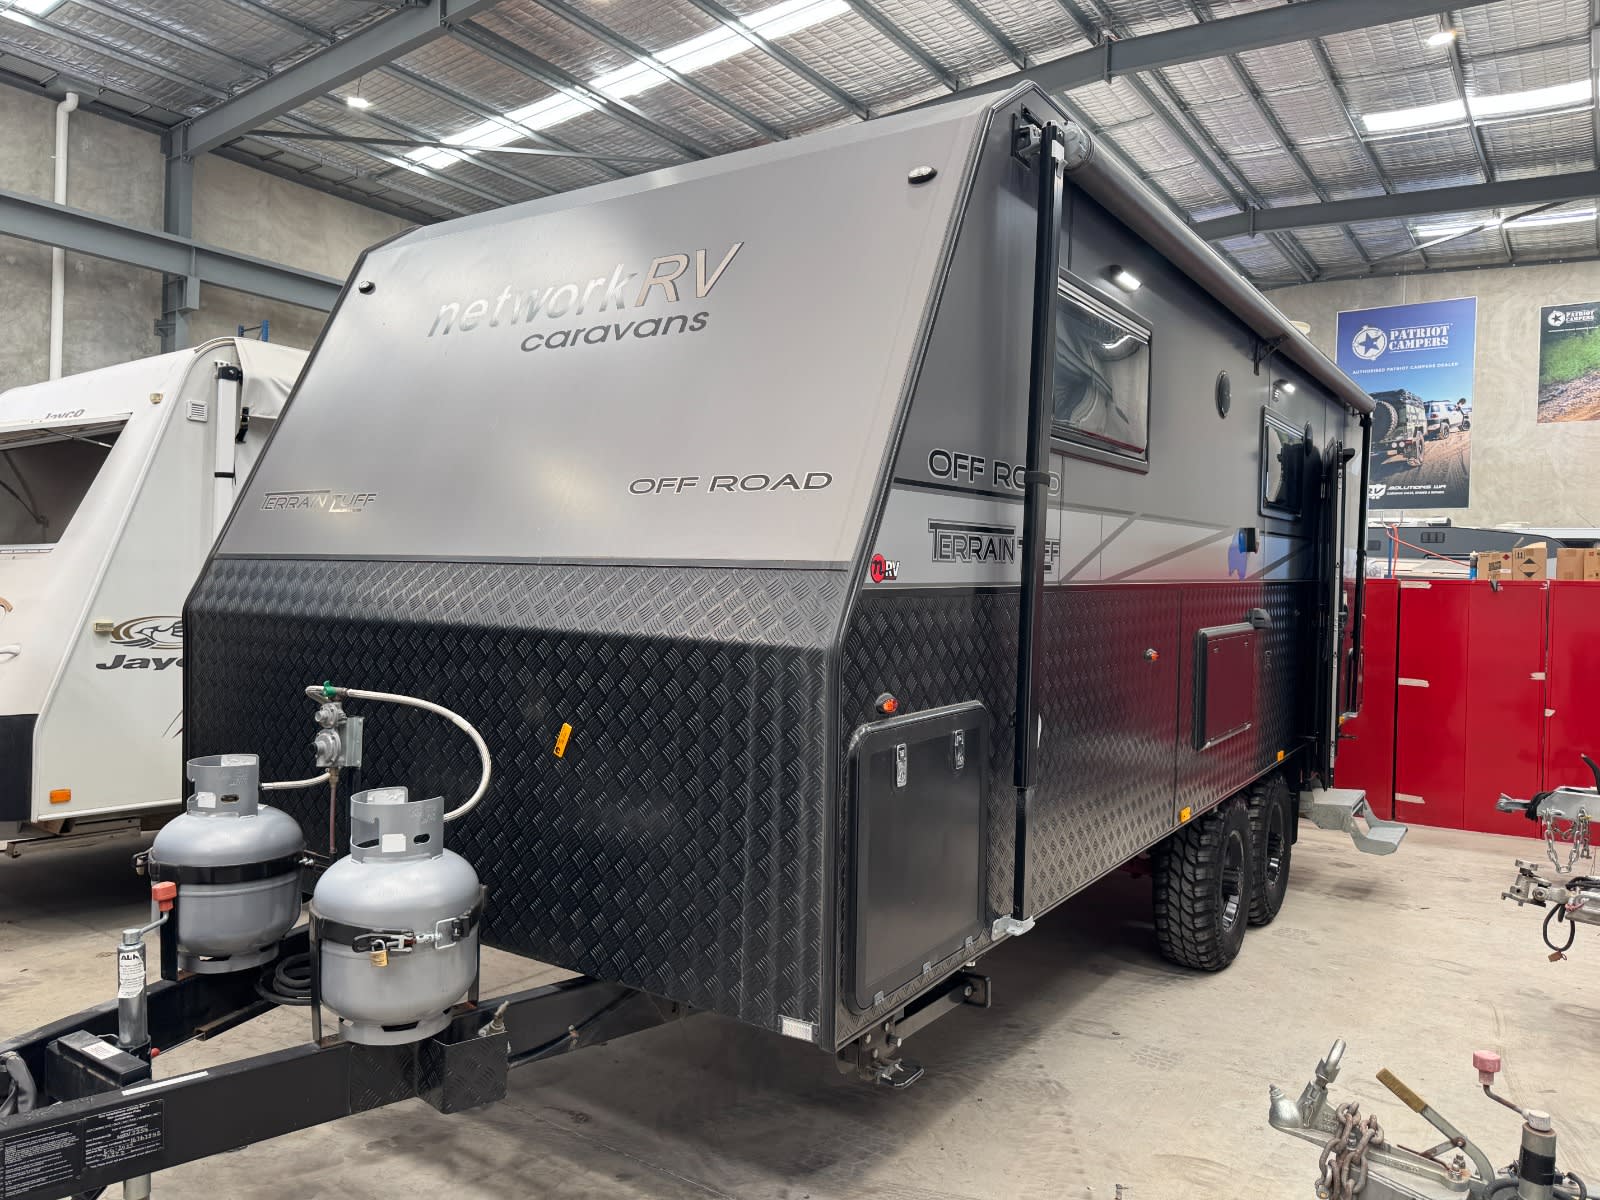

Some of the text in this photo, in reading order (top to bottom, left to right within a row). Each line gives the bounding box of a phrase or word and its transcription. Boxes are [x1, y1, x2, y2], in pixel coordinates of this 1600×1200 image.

[520, 311, 709, 352] caravans
[1390, 325, 1450, 340] PATRIOT
[1388, 336, 1449, 351] CAMPERS
[628, 471, 833, 495] OFF ROAD
[928, 448, 1061, 497] OFF ROD
[261, 489, 331, 511] TERRAIN
[928, 518, 1016, 564] TERRAIN
[96, 655, 183, 671] Jay
